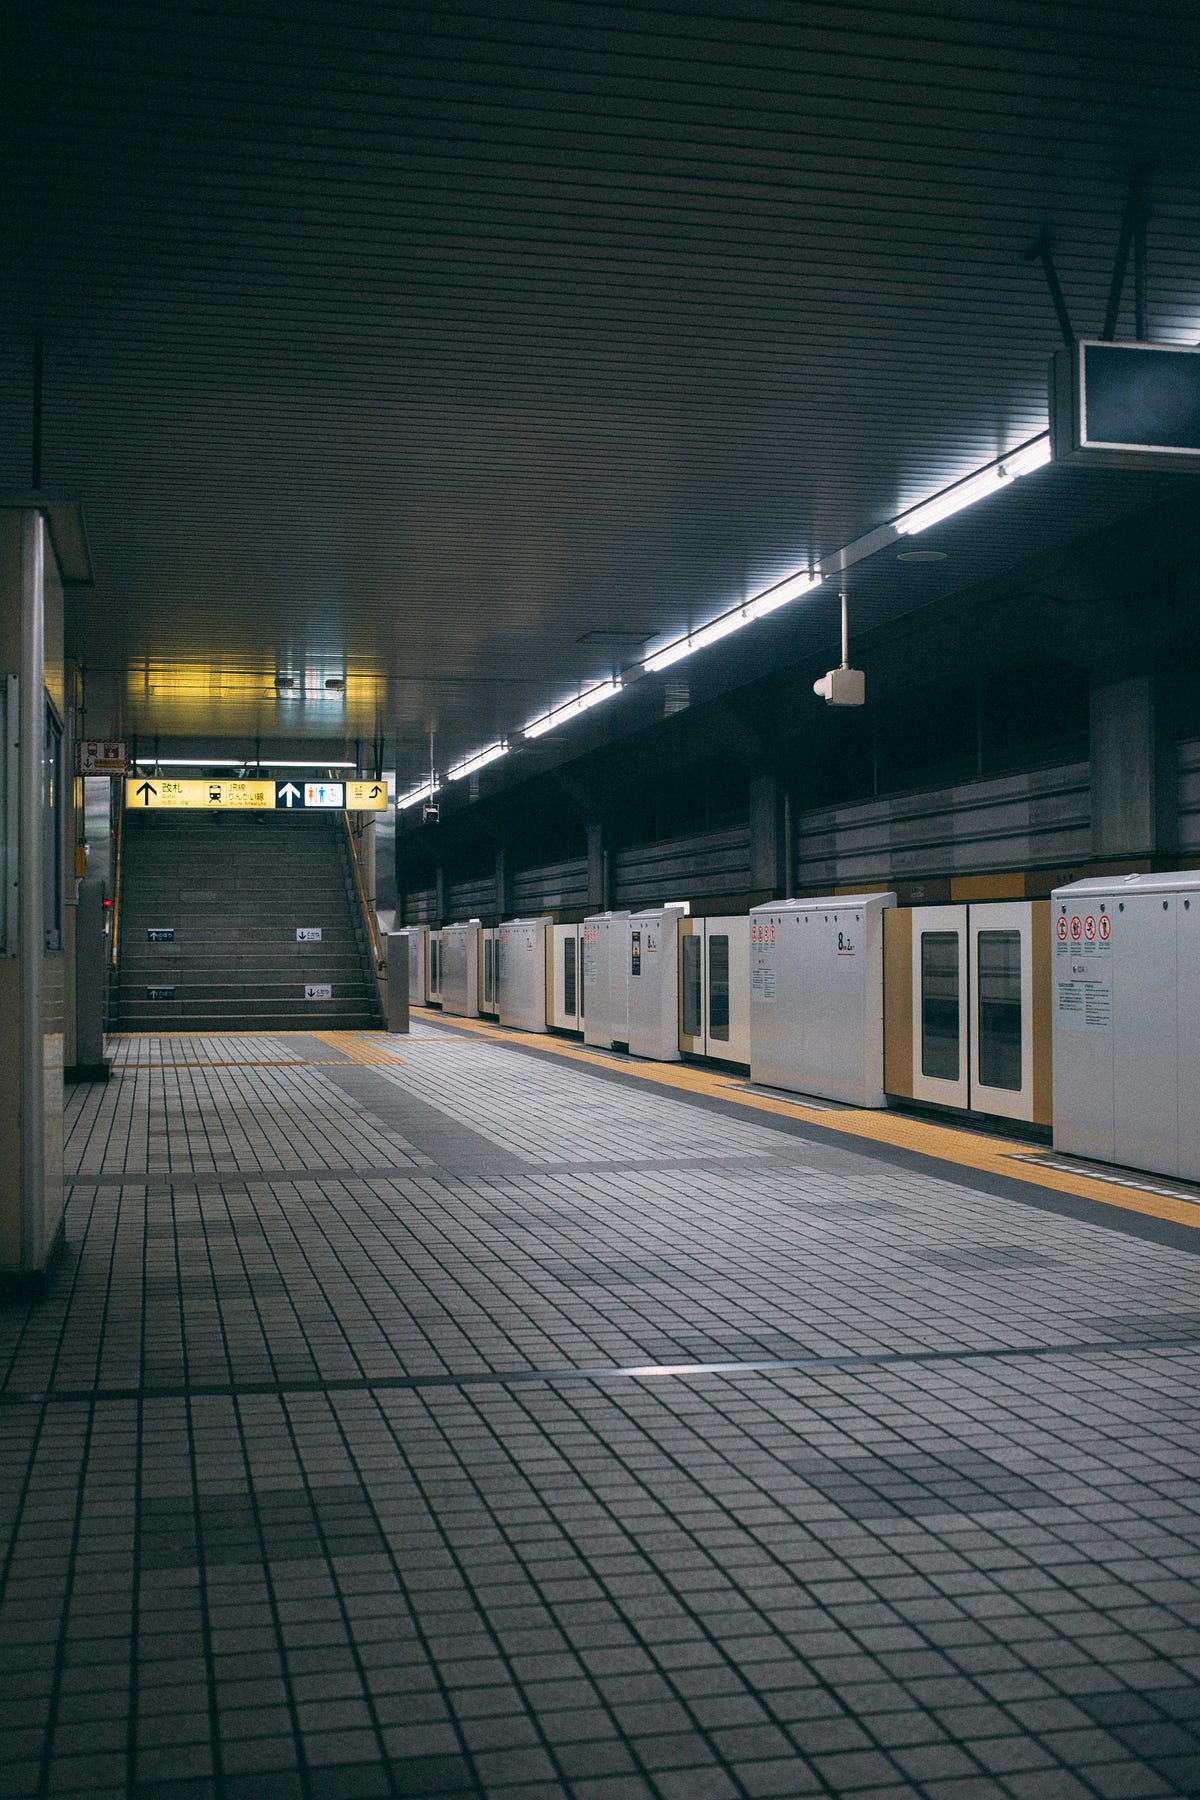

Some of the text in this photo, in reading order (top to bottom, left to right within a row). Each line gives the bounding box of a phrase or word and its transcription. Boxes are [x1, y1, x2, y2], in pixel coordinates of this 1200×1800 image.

[161, 782, 183, 794] 改札
[229, 783, 246, 793] JR線
[229, 792, 265, 802] りんかい線
[838, 931, 844, 951] 8
